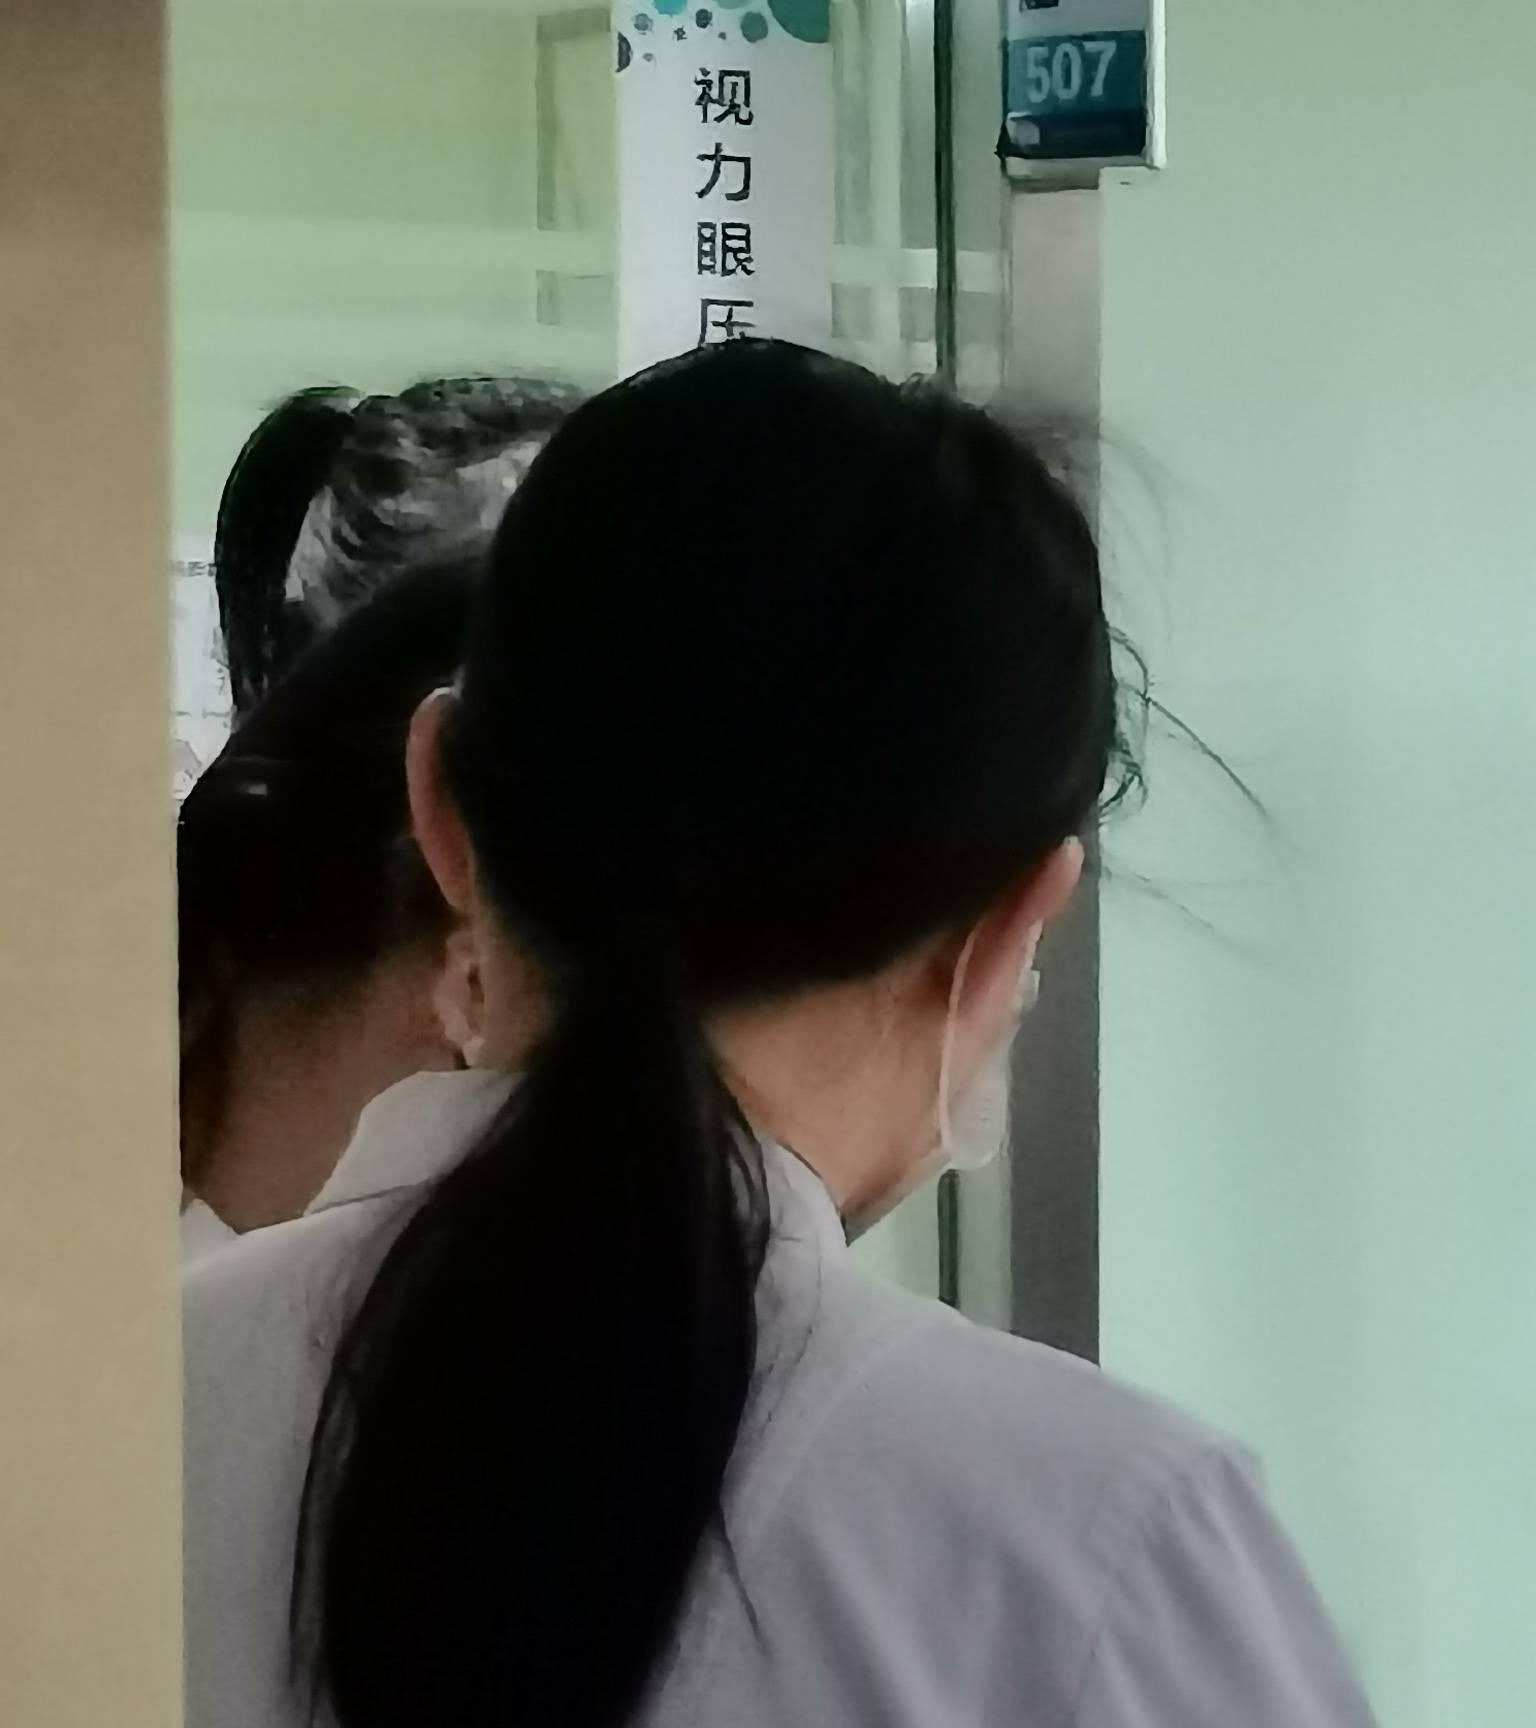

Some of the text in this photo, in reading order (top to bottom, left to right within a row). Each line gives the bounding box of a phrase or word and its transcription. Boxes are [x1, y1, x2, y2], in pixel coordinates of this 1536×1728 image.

[1026, 40, 1117, 104] 507
[694, 66, 756, 345] 视力眼压
